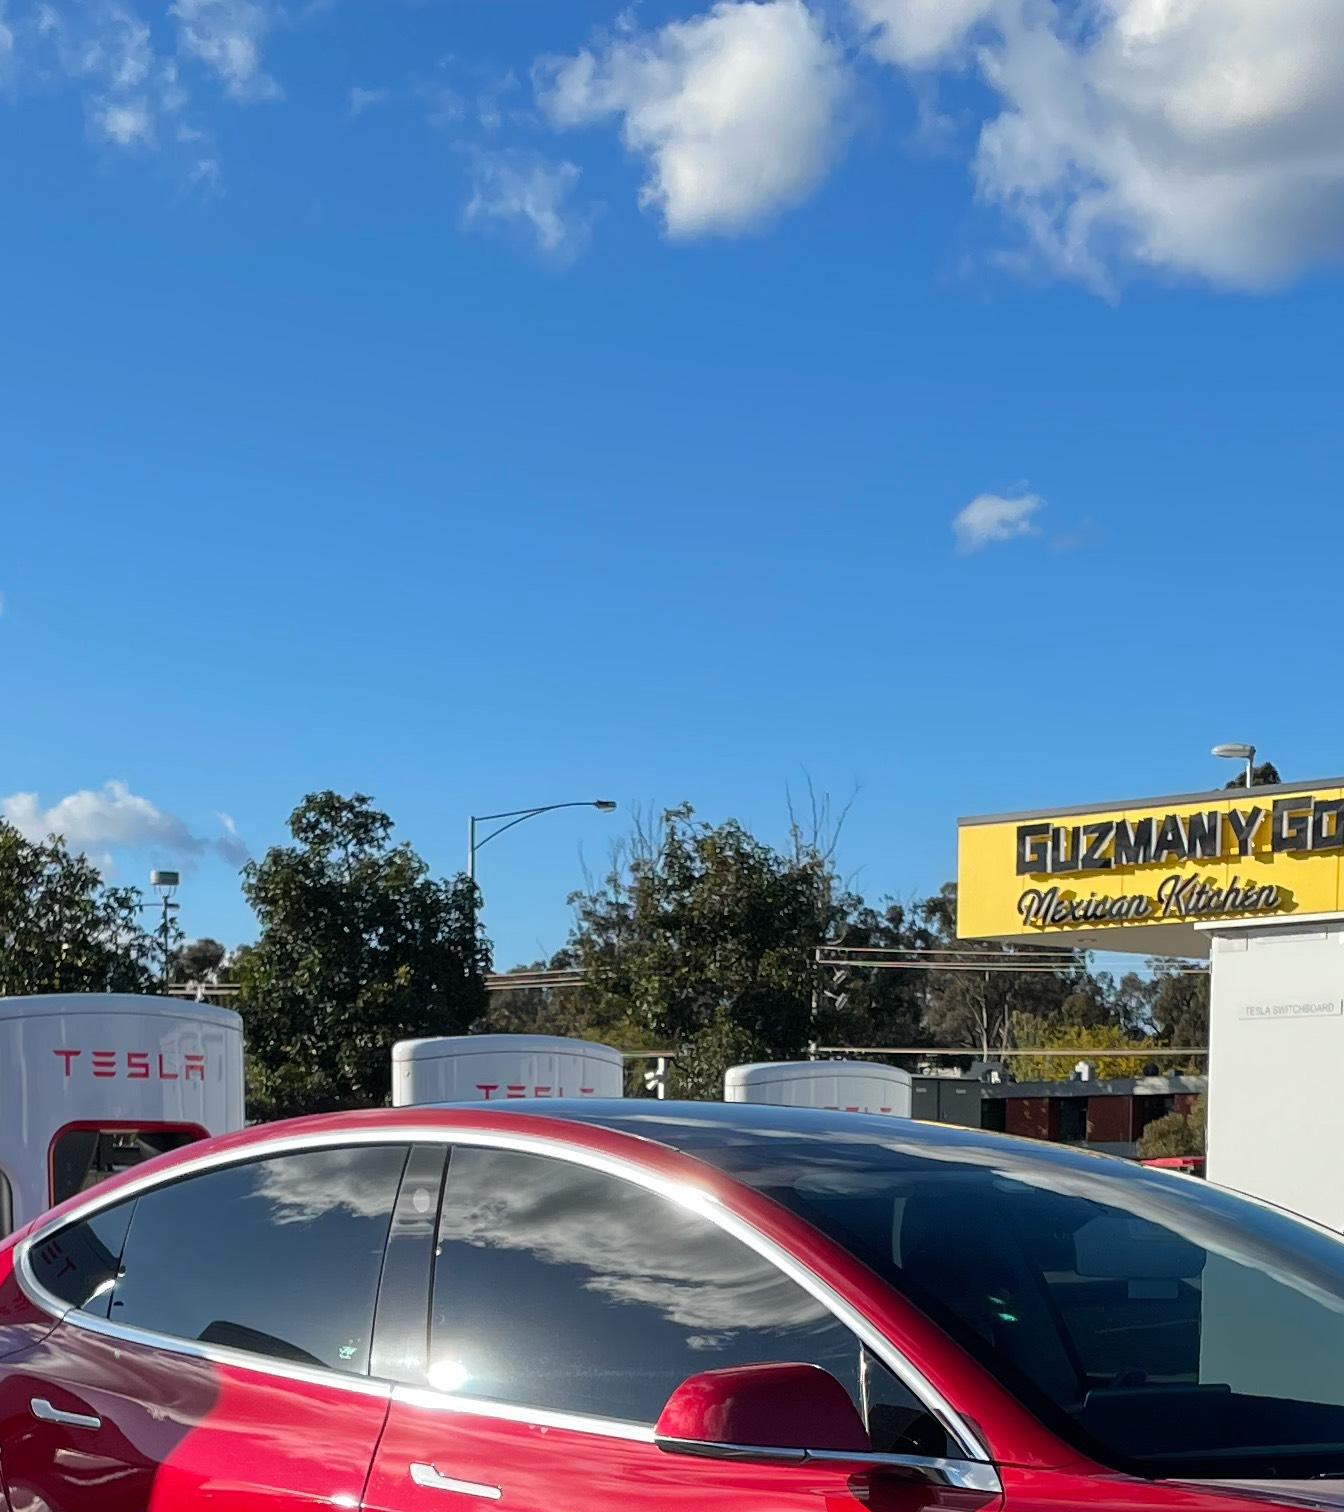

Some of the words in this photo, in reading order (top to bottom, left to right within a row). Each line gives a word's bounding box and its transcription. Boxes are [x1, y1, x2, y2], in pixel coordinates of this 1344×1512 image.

[1016, 810, 1222, 876] GUZMAN
[1227, 806, 1265, 857] Y
[1017, 886, 1153, 927] Mexican
[1157, 872, 1283, 919] Kitchen
[1246, 1006, 1270, 1016] TESLA
[1272, 1002, 1335, 1015] SWITCHBOARD
[53, 1049, 205, 1081] TESLA
